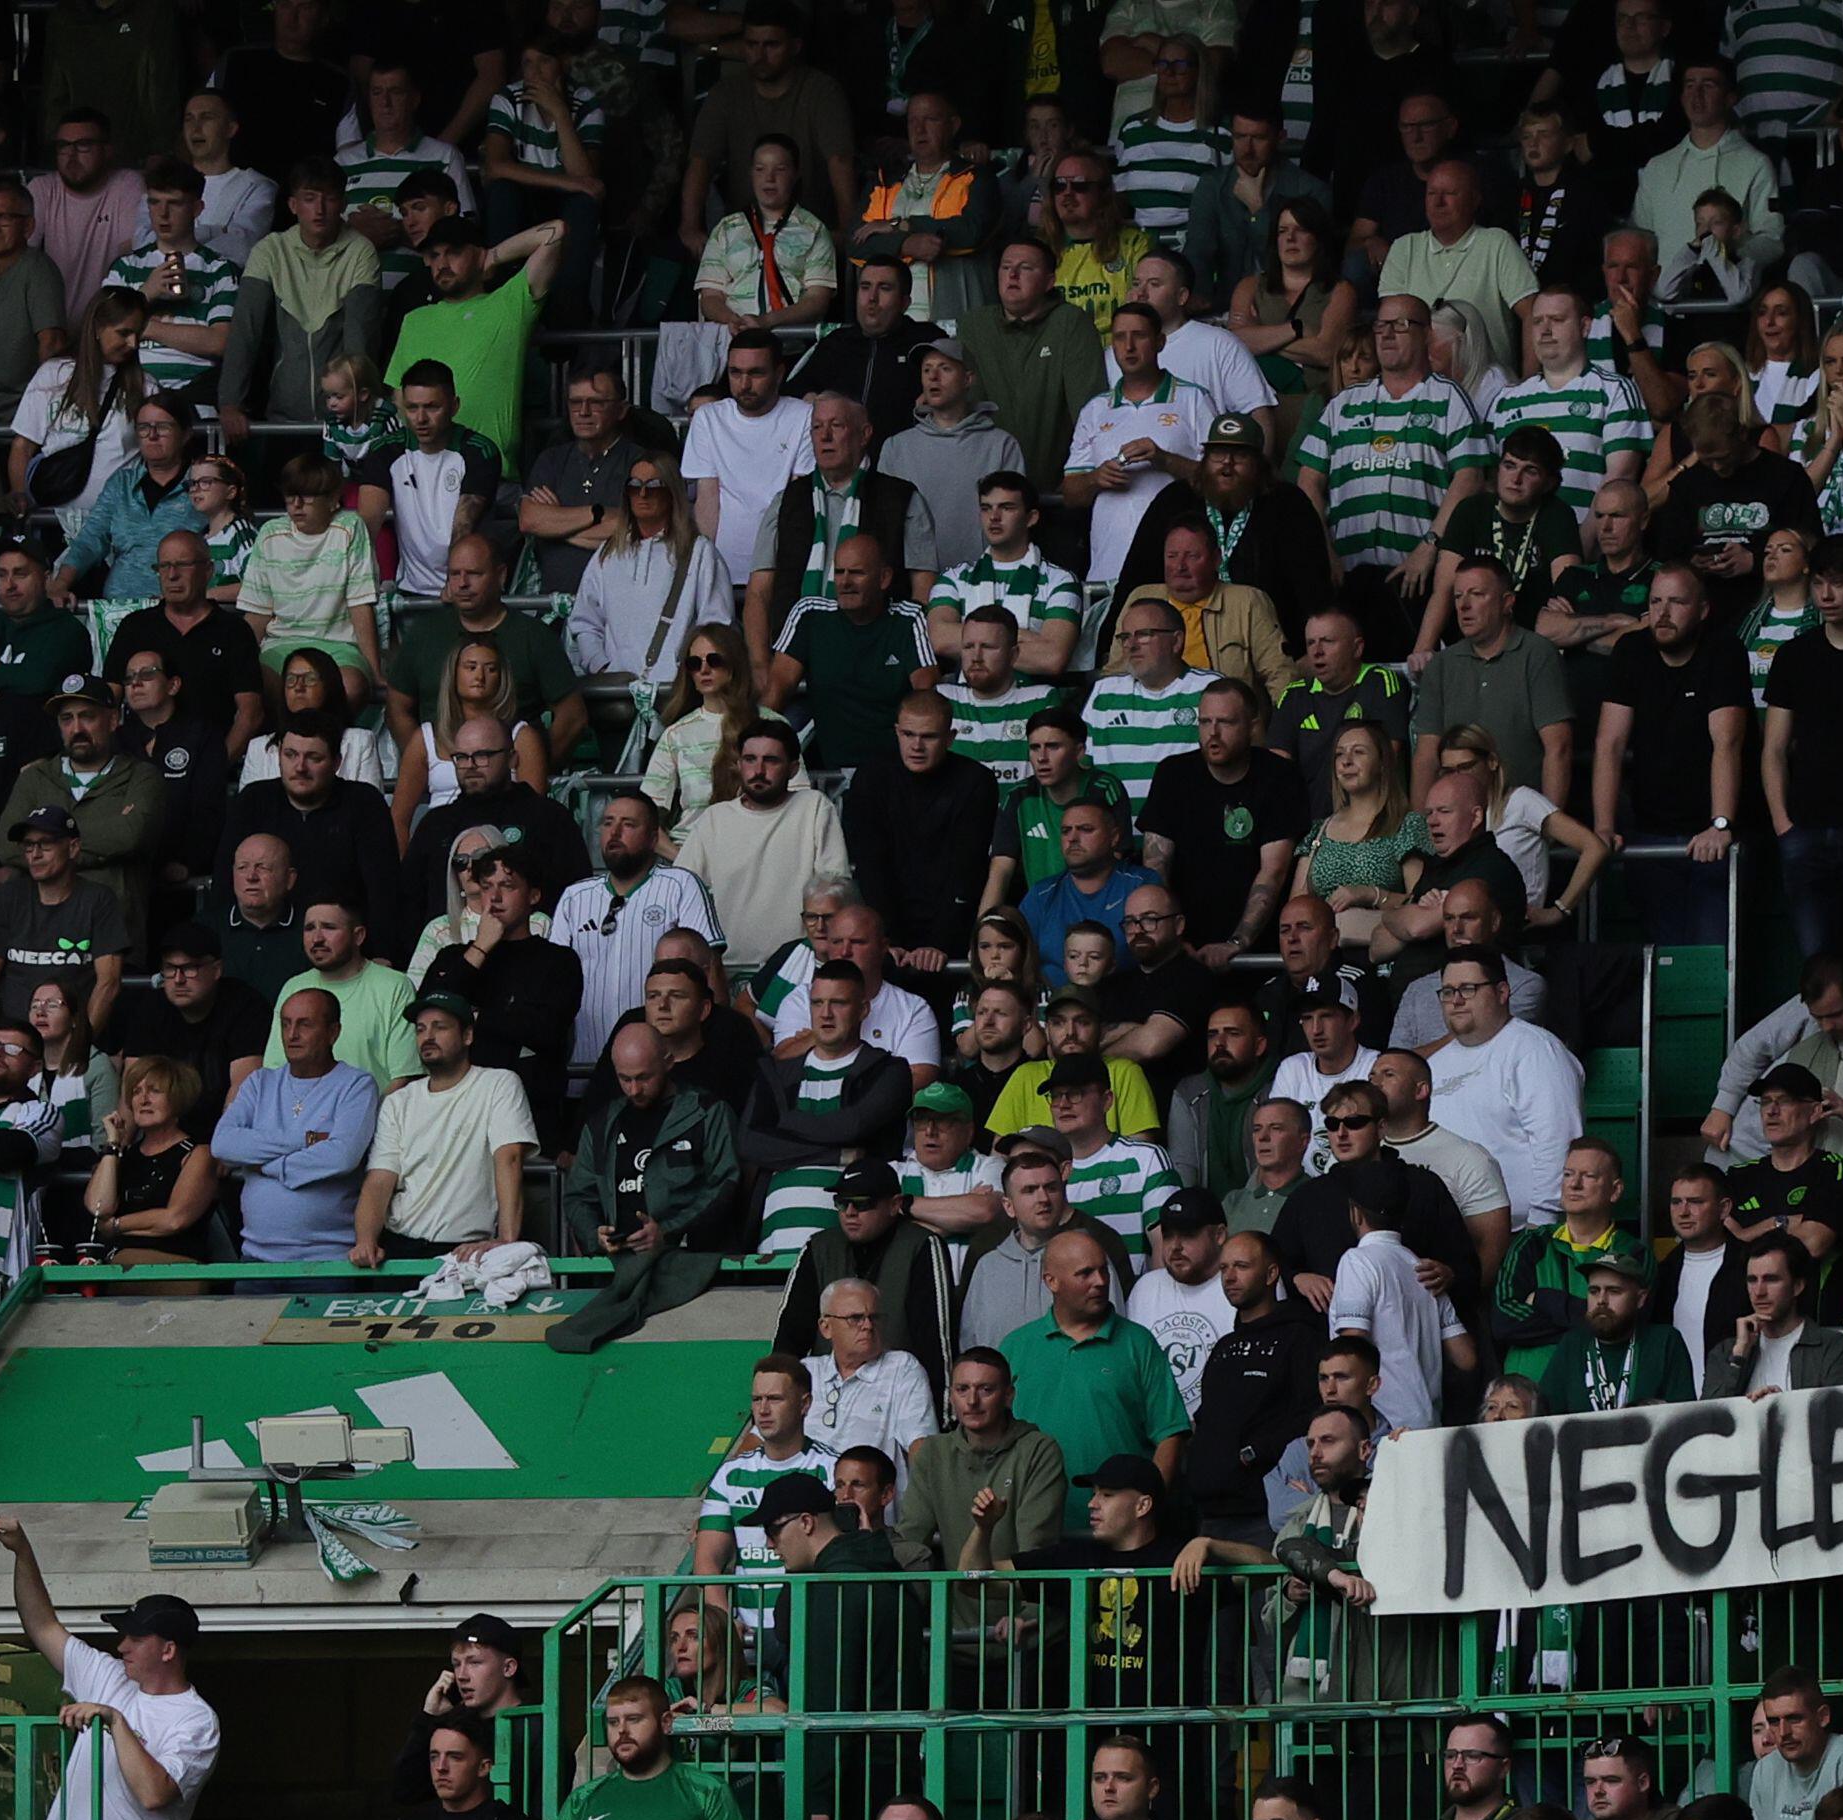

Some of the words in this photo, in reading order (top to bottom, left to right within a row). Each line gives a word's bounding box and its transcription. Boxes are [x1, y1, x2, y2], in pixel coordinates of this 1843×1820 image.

[1068, 284, 1111, 300] SMITH
[1352, 456, 1412, 472] dafabet
[322, 1298, 429, 1318] EXIT
[1154, 1315, 1208, 1334] LACOSTE
[205, 1550, 250, 1562] BRIGA
[741, 1543, 782, 1564] dafa
